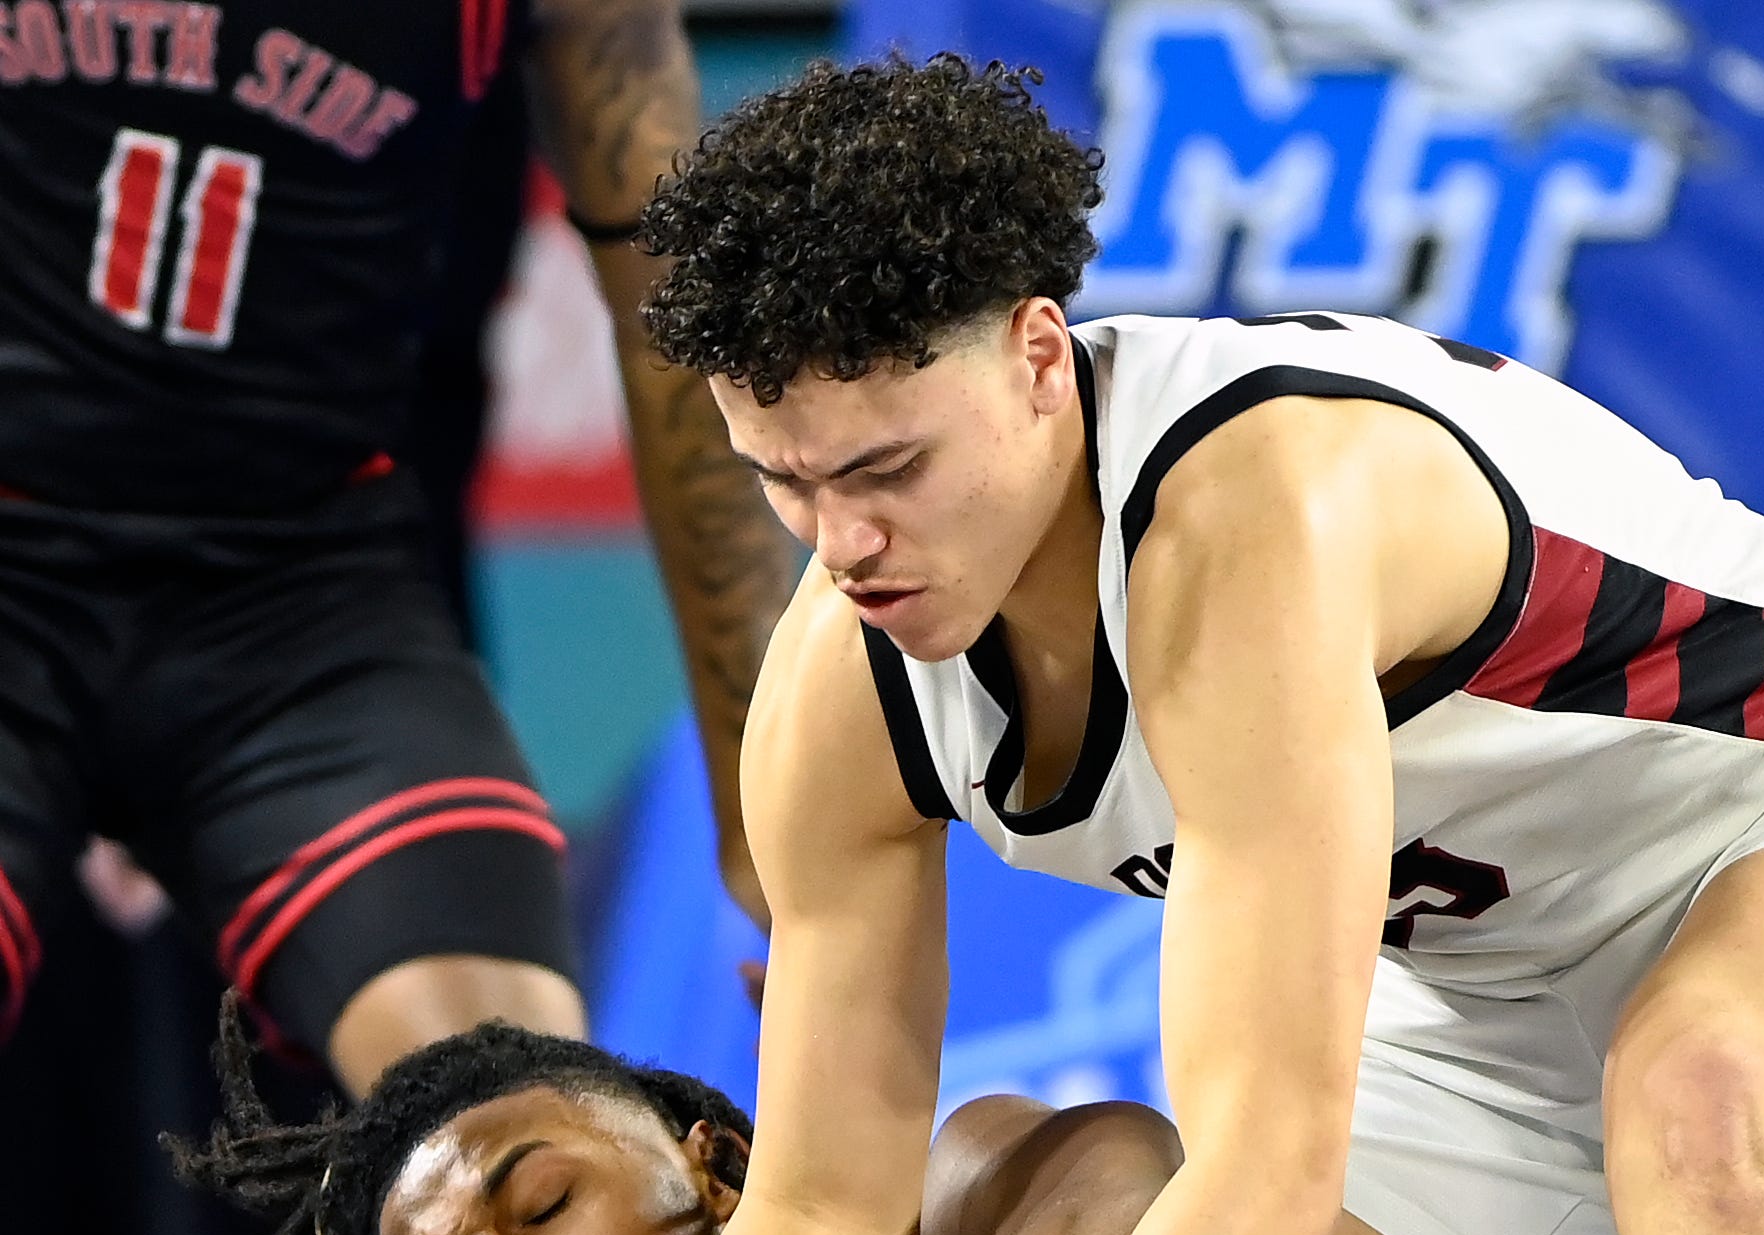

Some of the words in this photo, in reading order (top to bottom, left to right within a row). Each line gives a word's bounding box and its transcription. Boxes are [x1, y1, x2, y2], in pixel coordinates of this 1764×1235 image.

[232, 26, 420, 162] SIDE
[1080, 10, 1678, 376] MT
[89, 126, 264, 350] 11
